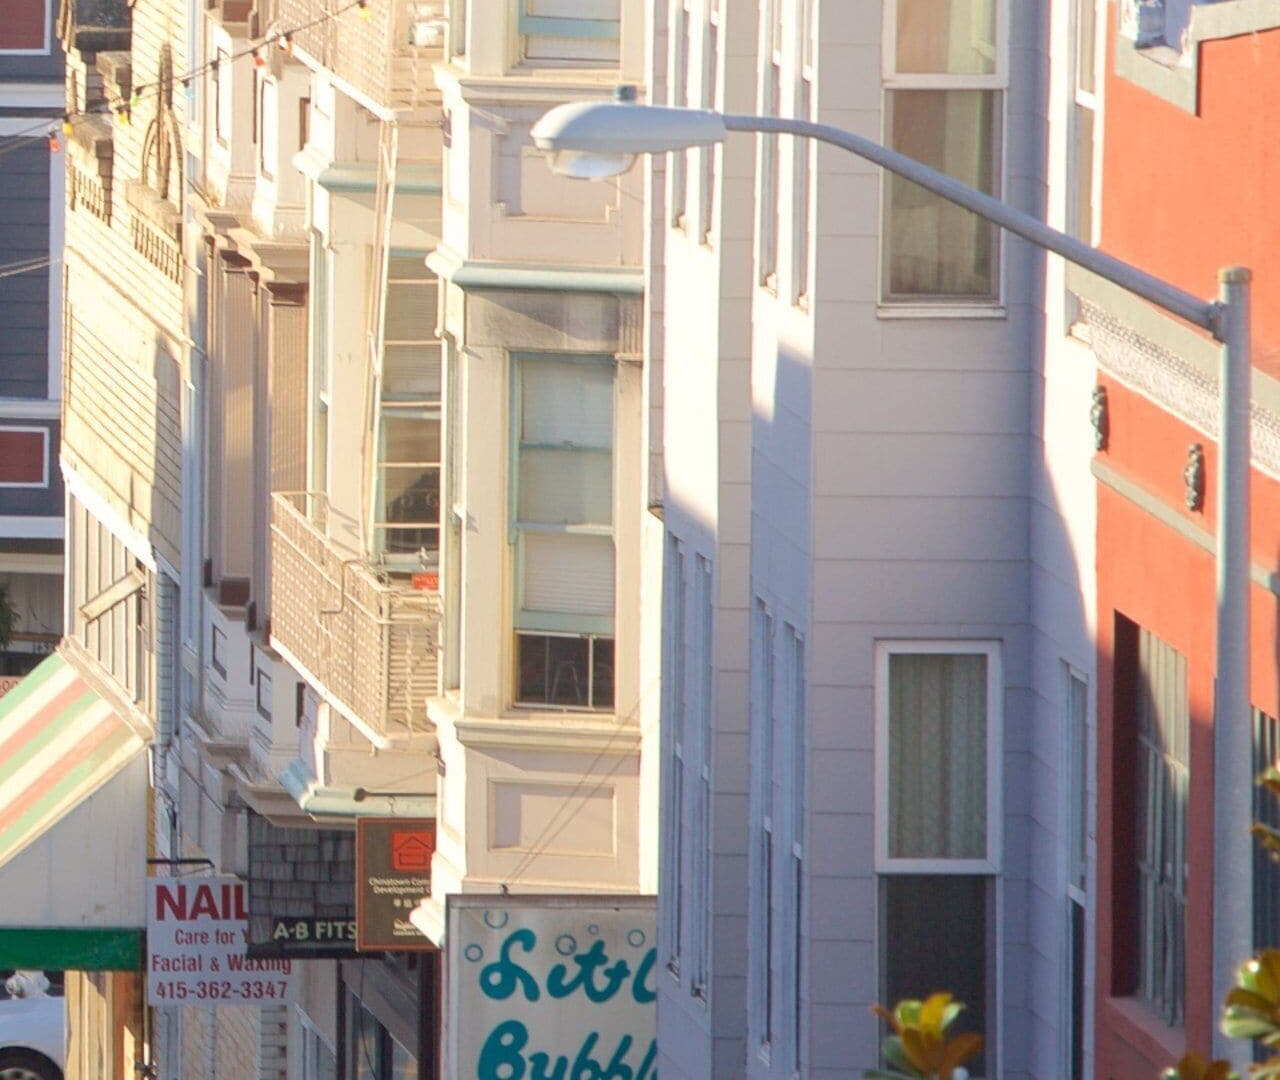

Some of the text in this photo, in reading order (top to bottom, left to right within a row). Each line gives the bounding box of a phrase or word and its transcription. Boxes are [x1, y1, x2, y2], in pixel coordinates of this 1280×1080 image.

[175, 928, 236, 945] Care for
[272, 921, 357, 940] A-B FITS
[152, 953, 292, 975] Facial & Waxing
[156, 980, 288, 1000] 415-362-3347
